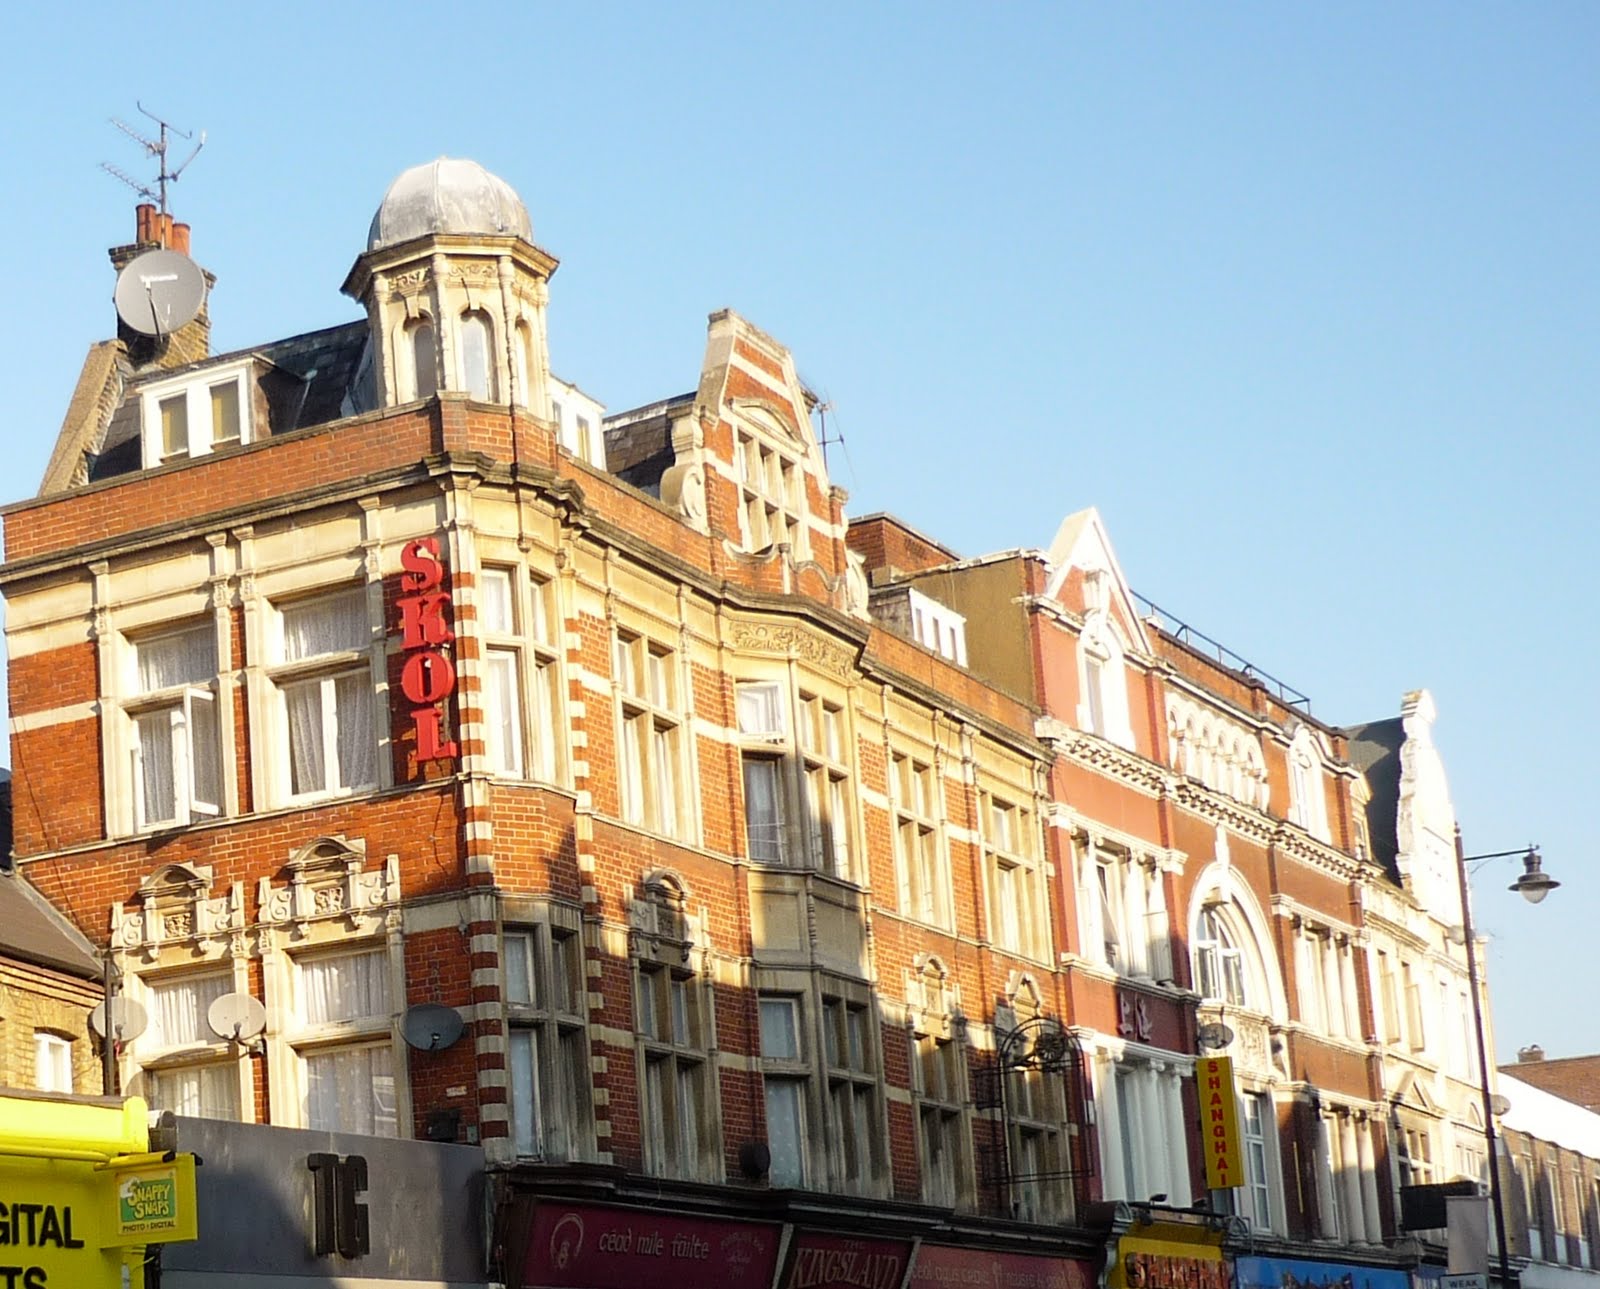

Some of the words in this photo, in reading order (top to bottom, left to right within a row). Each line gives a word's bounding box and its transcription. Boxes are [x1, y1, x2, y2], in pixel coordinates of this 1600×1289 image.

[397, 537, 457, 761] SKOL
[1207, 1061, 1228, 1186] SHANGHAI
[127, 1183, 171, 1206] SNAPPY
[134, 1200, 170, 1219] SNAPS
[122, 1223, 146, 1232] PHOTO
[150, 1220, 176, 1230] DIGITAL
[787, 1248, 900, 1289] KINGSLAND
[1448, 1280, 1478, 1288] WEAK
